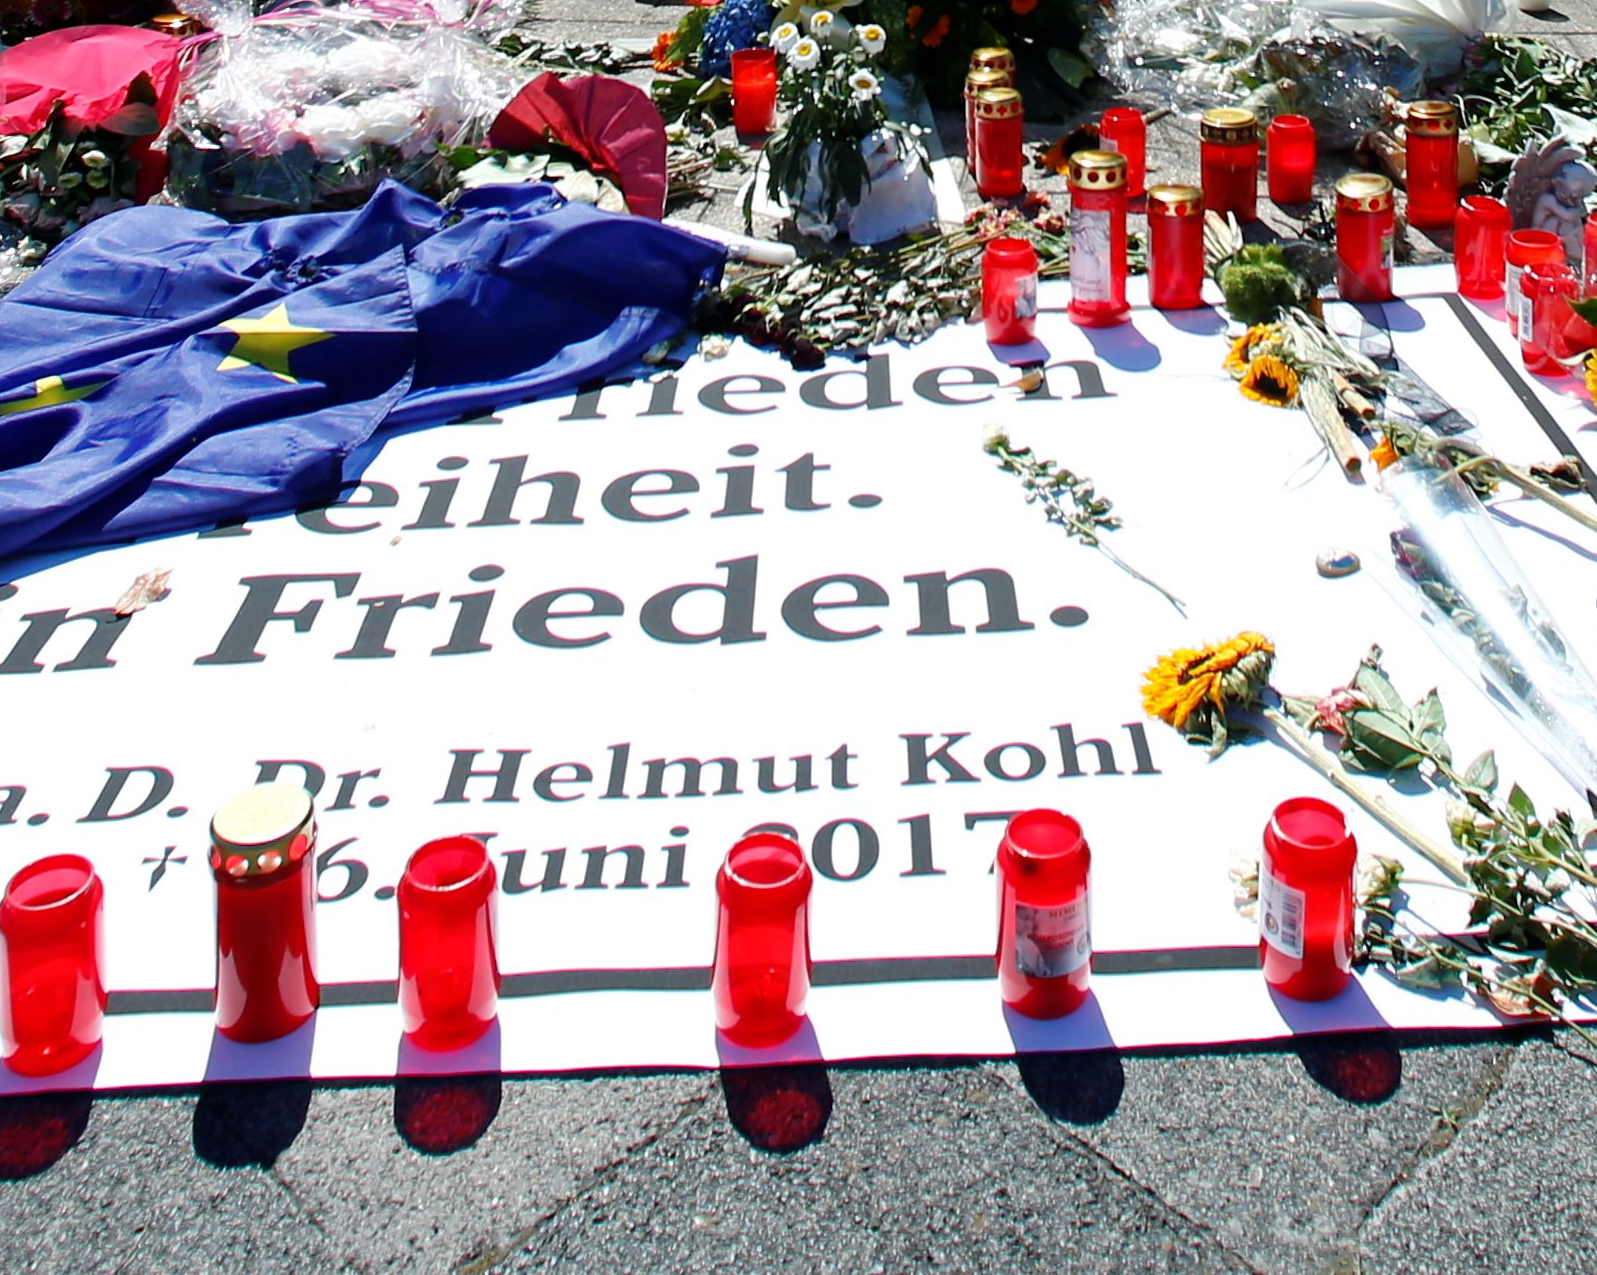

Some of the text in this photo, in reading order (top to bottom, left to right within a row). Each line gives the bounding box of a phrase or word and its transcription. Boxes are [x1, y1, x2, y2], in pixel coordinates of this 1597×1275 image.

[447, 352, 1118, 425] rieden
[193, 554, 1090, 665] Frieden.
[76, 766, 188, 823] D.
[433, 742, 859, 804] Helmut
[899, 722, 1163, 786] Kohl
[317, 837, 395, 904] 6.
